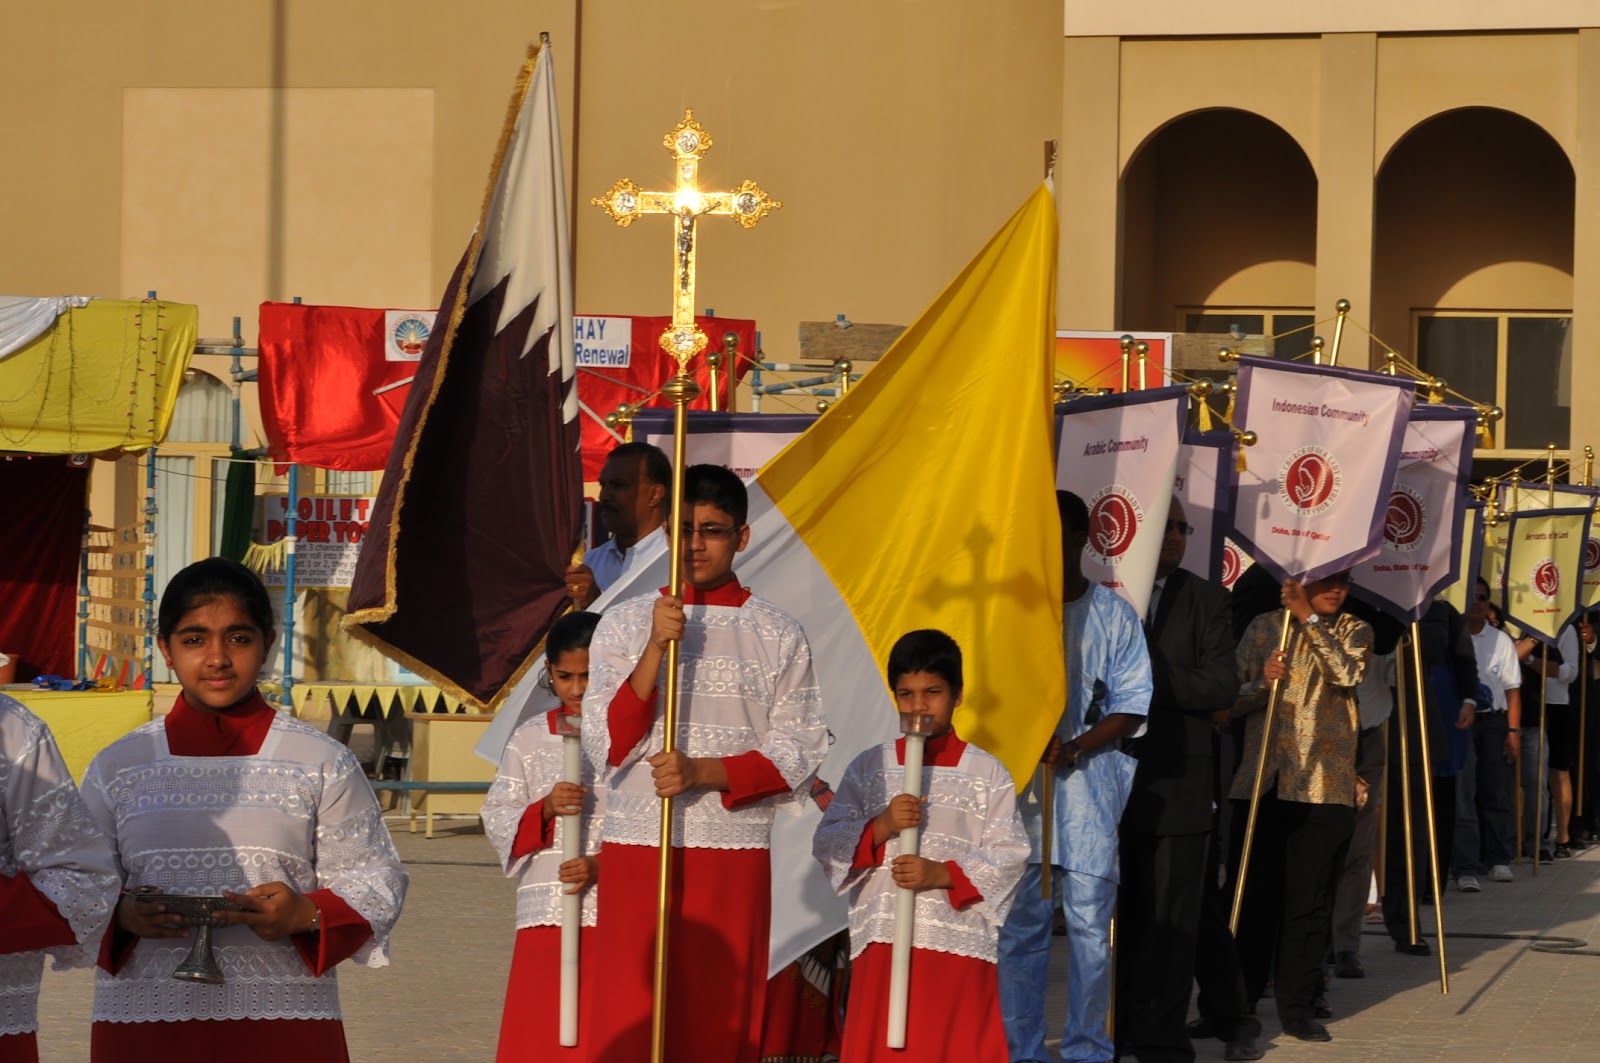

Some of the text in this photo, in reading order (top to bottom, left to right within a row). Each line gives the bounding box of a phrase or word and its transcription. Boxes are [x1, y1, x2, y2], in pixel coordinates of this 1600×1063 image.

[575, 342, 629, 365] Renewal
[1272, 398, 1370, 427] Indonesian Community
[1083, 435, 1150, 456] Arabic Community
[315, 544, 344, 552] chances
